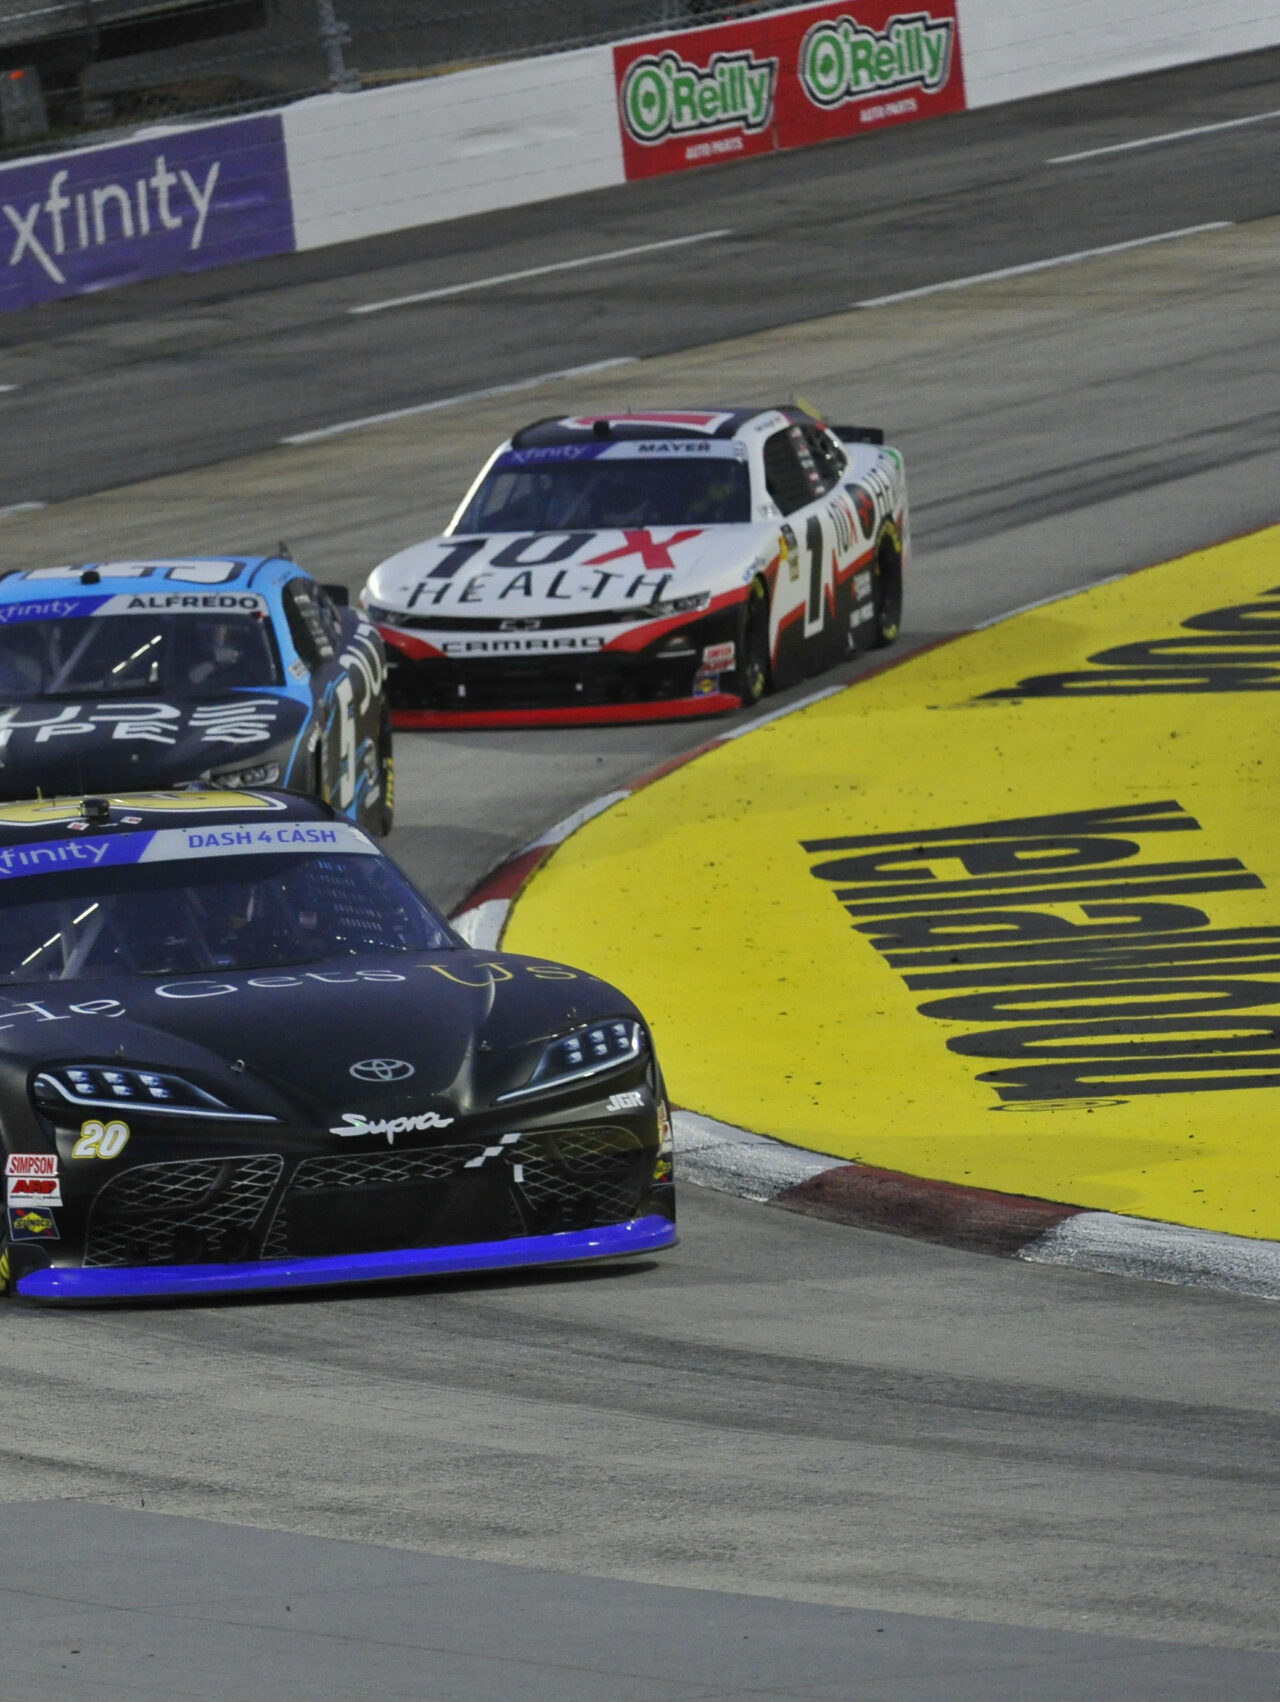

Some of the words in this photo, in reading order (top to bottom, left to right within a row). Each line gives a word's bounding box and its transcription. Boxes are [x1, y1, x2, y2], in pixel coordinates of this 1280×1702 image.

[807, 25, 944, 97] O'Reilly
[629, 61, 769, 133] O'Reilly
[2, 154, 221, 285] xfinity
[510, 444, 590, 464] xfinity
[637, 440, 712, 454] MAYER
[426, 529, 708, 580] 10X
[127, 594, 260, 610] ALFREDO
[406, 568, 675, 609] HEALTH
[441, 636, 606, 654] CAMARO
[188, 832, 253, 849] DASH
[256, 830, 273, 844] 4
[277, 828, 338, 844] CASH
[154, 967, 408, 1000] Gets
[606, 1091, 645, 1112] JGR
[71, 1118, 130, 1161] 20
[328, 1111, 454, 1146] Supra
[9, 1156, 55, 1174] SIMPSON
[10, 1179, 58, 1194] ARP
[12, 1217, 53, 1230] SUNOCO
